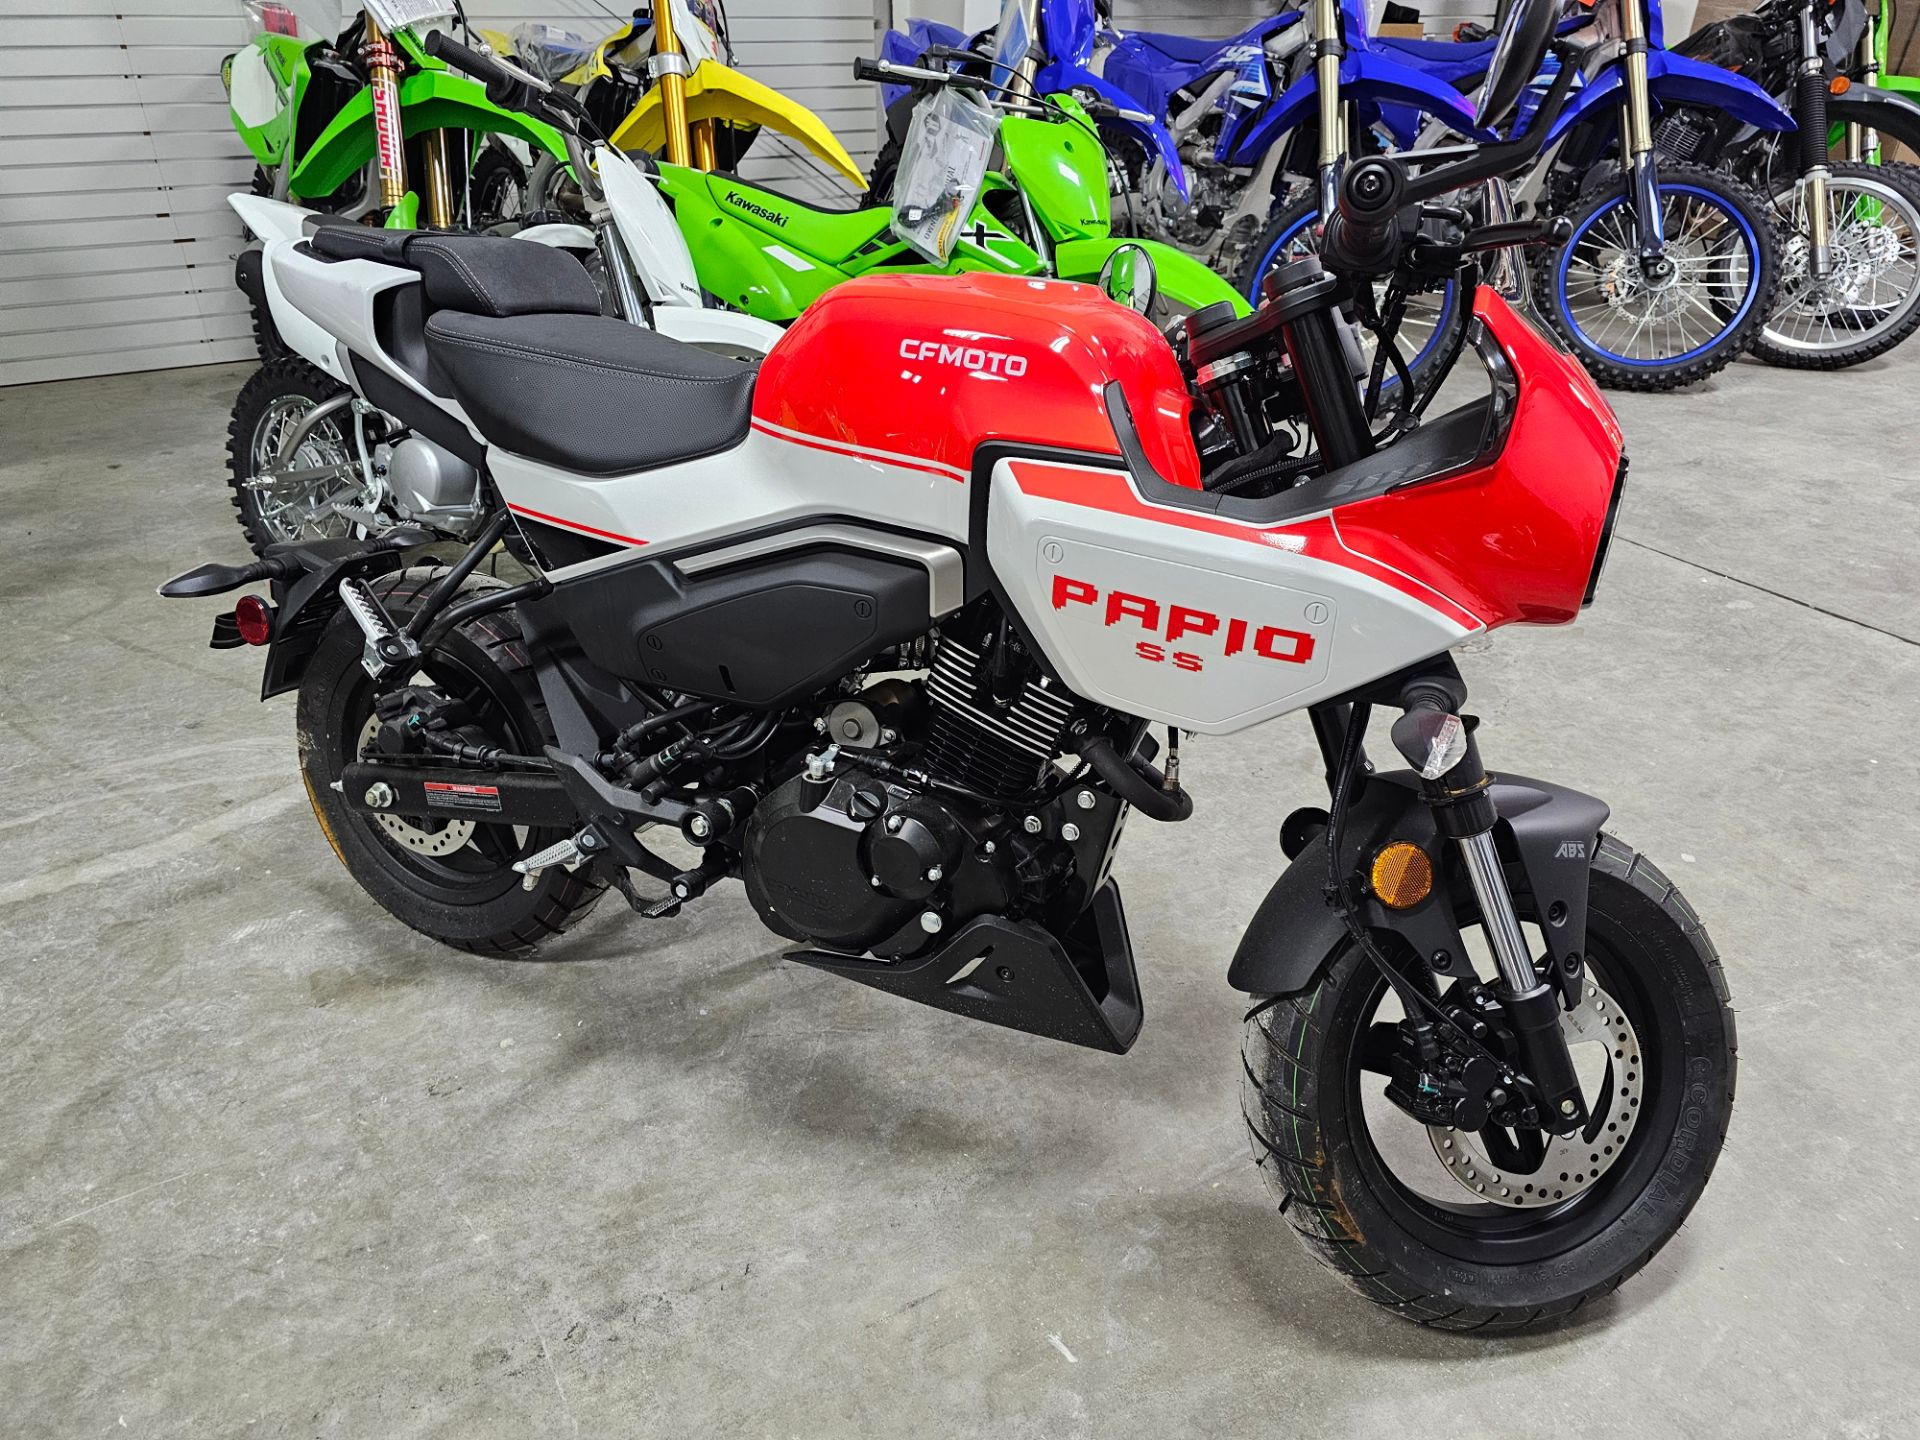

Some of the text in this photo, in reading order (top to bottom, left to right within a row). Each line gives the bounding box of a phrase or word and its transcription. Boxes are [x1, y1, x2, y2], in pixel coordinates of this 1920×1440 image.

[374, 87, 392, 169] SHOWA
[725, 191, 789, 227] Kawasaki
[899, 338, 1028, 377] CFMOTO
[1051, 574, 1316, 665] PAPIO
[1135, 641, 1204, 673] SS
[1554, 840, 1586, 858] ABS
